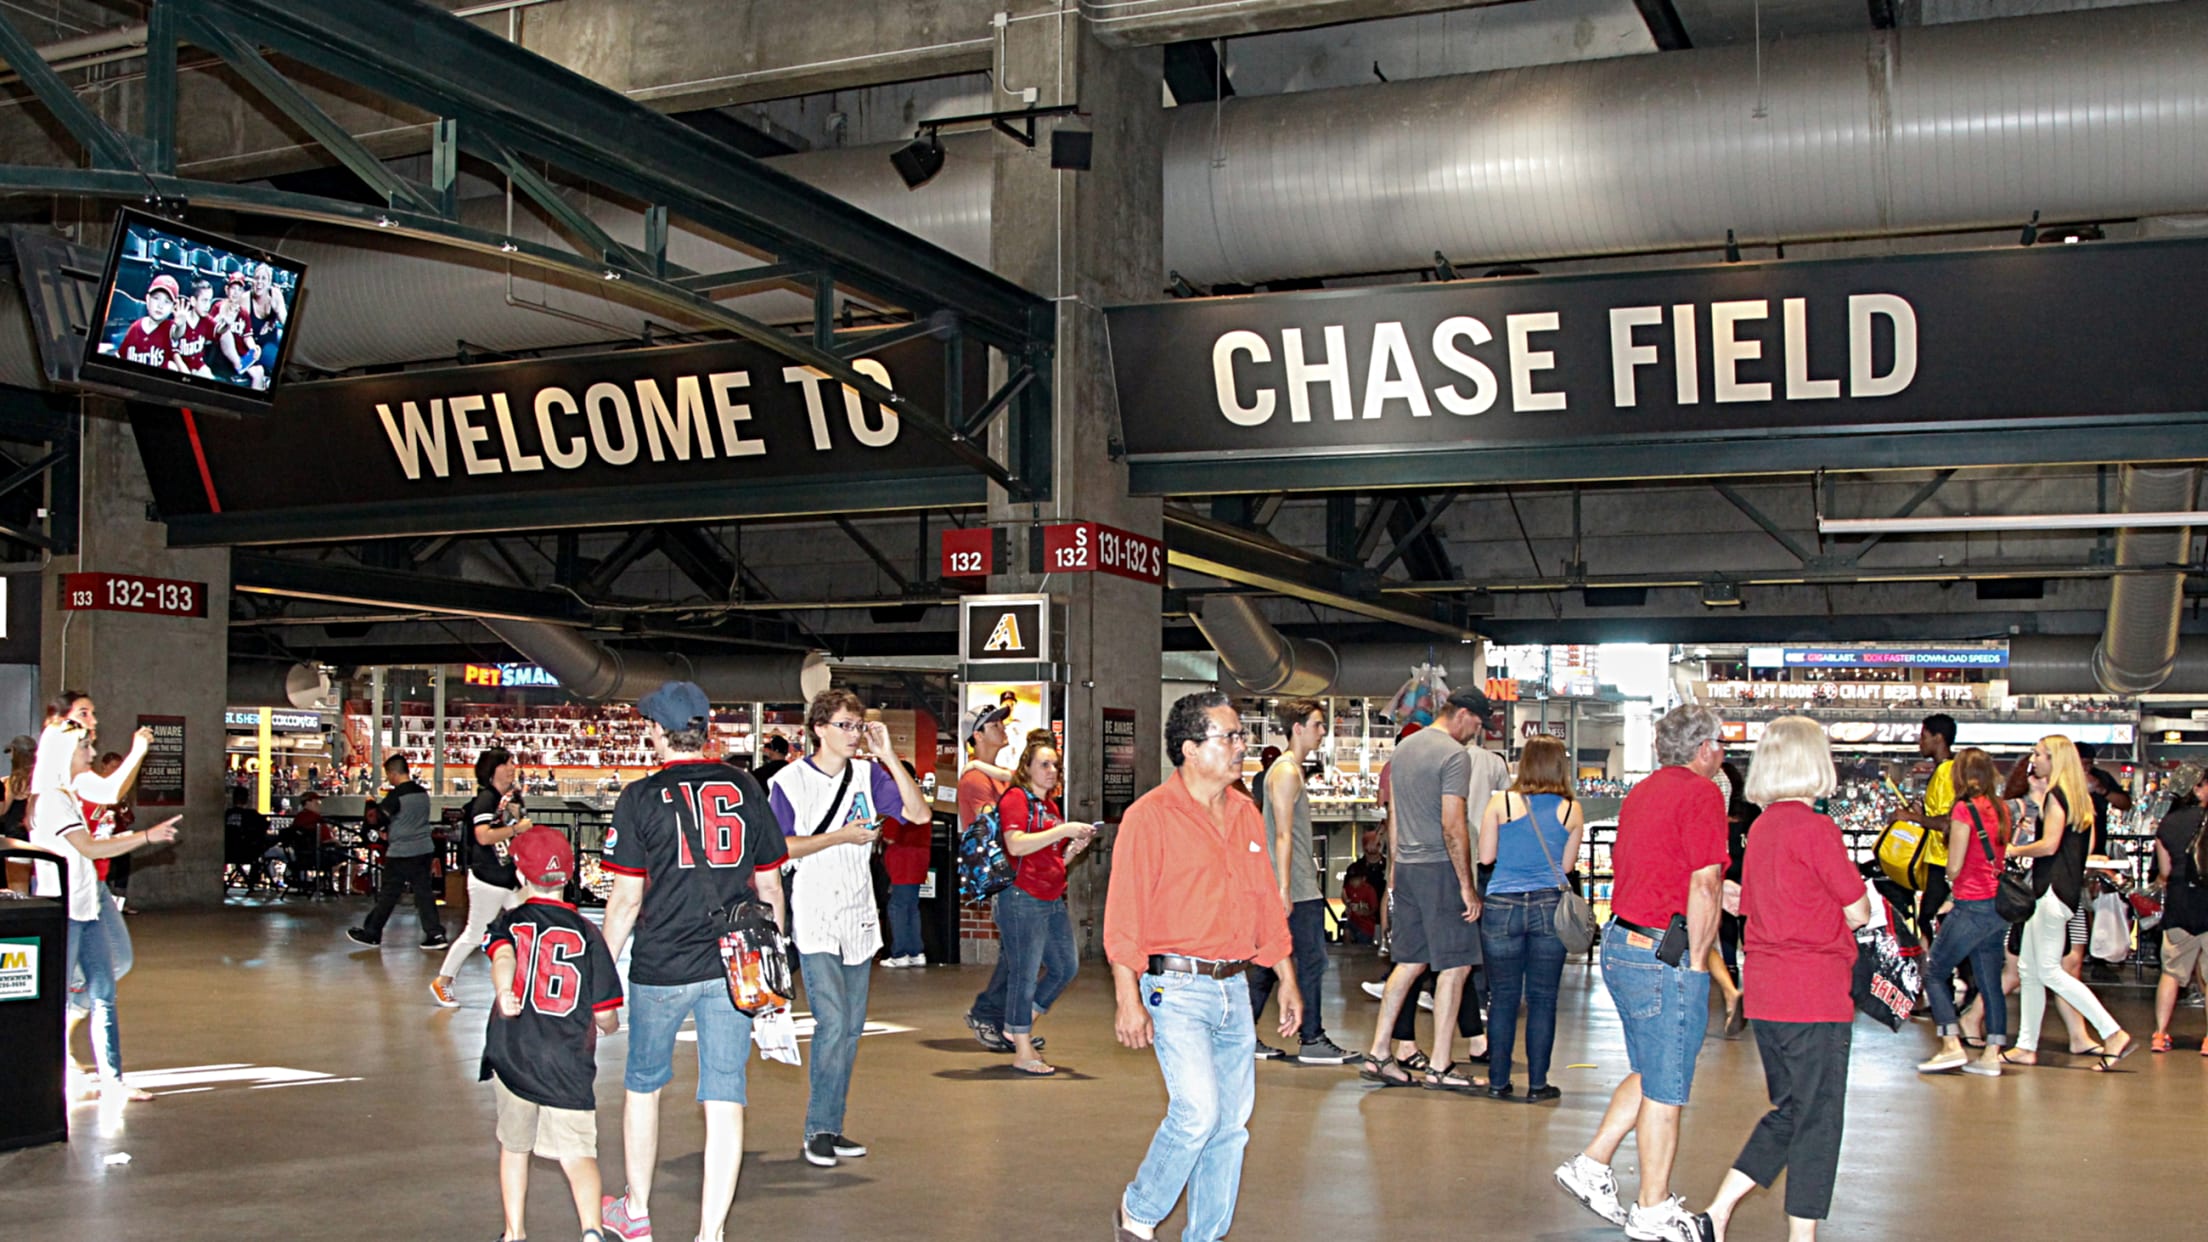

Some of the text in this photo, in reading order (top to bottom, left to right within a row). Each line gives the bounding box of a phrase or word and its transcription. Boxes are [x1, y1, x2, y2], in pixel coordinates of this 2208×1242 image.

[1212, 294, 1919, 426] CHASE FIELD
[376, 358, 900, 480] WELCOME TO
[1075, 527, 1088, 547] S
[950, 552, 982, 572] 132
[1055, 548, 1088, 567] 132
[1099, 531, 1161, 577] 131-132 S
[72, 591, 93, 606] 133
[106, 578, 193, 611] 132-133
[1884, 653, 1916, 663] FASTER
[1916, 653, 1968, 663] DOWNLOAD
[1968, 653, 2001, 663] SPEEDS
[465, 663, 559, 686] PETSMA
[1706, 683, 1732, 698] THE
[1840, 684, 1882, 699] CRAFT
[1883, 684, 1917, 700] BEER
[153, 725, 183, 737] AWARE
[509, 922, 586, 1017] 16
